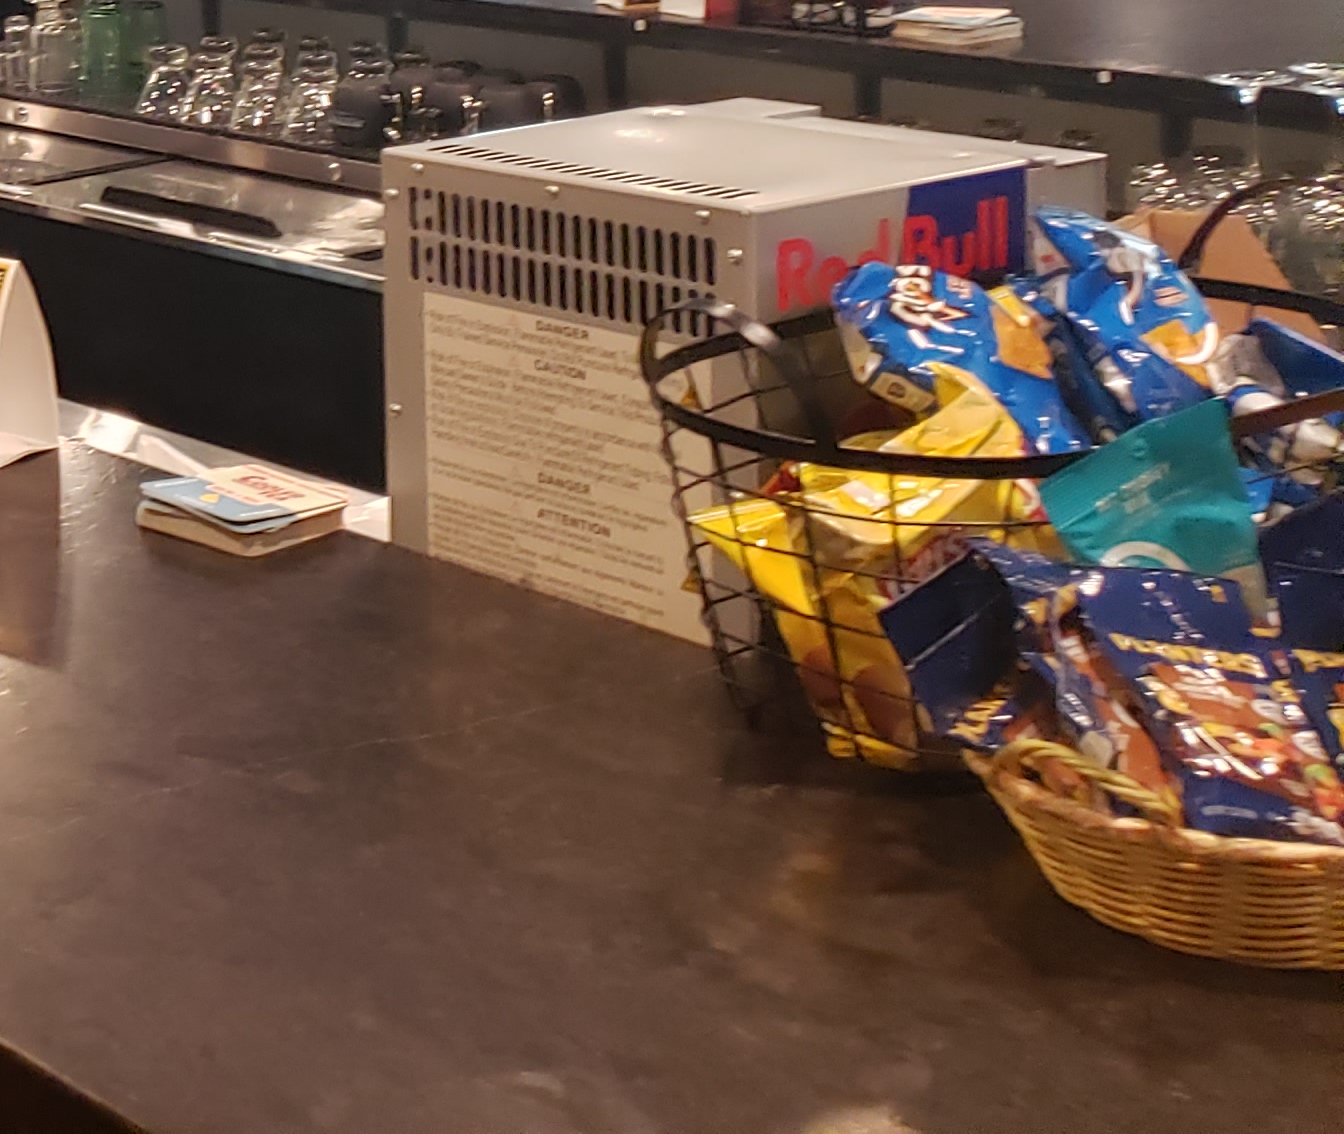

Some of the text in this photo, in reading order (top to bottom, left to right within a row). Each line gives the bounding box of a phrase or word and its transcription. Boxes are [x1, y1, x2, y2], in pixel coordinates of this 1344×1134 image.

[901, 195, 1009, 277] Bull
[535, 320, 590, 340] DANGER
[534, 358, 588, 381] CAUTION
[537, 471, 591, 495] DANGER
[537, 508, 611, 539] ATTENTION
